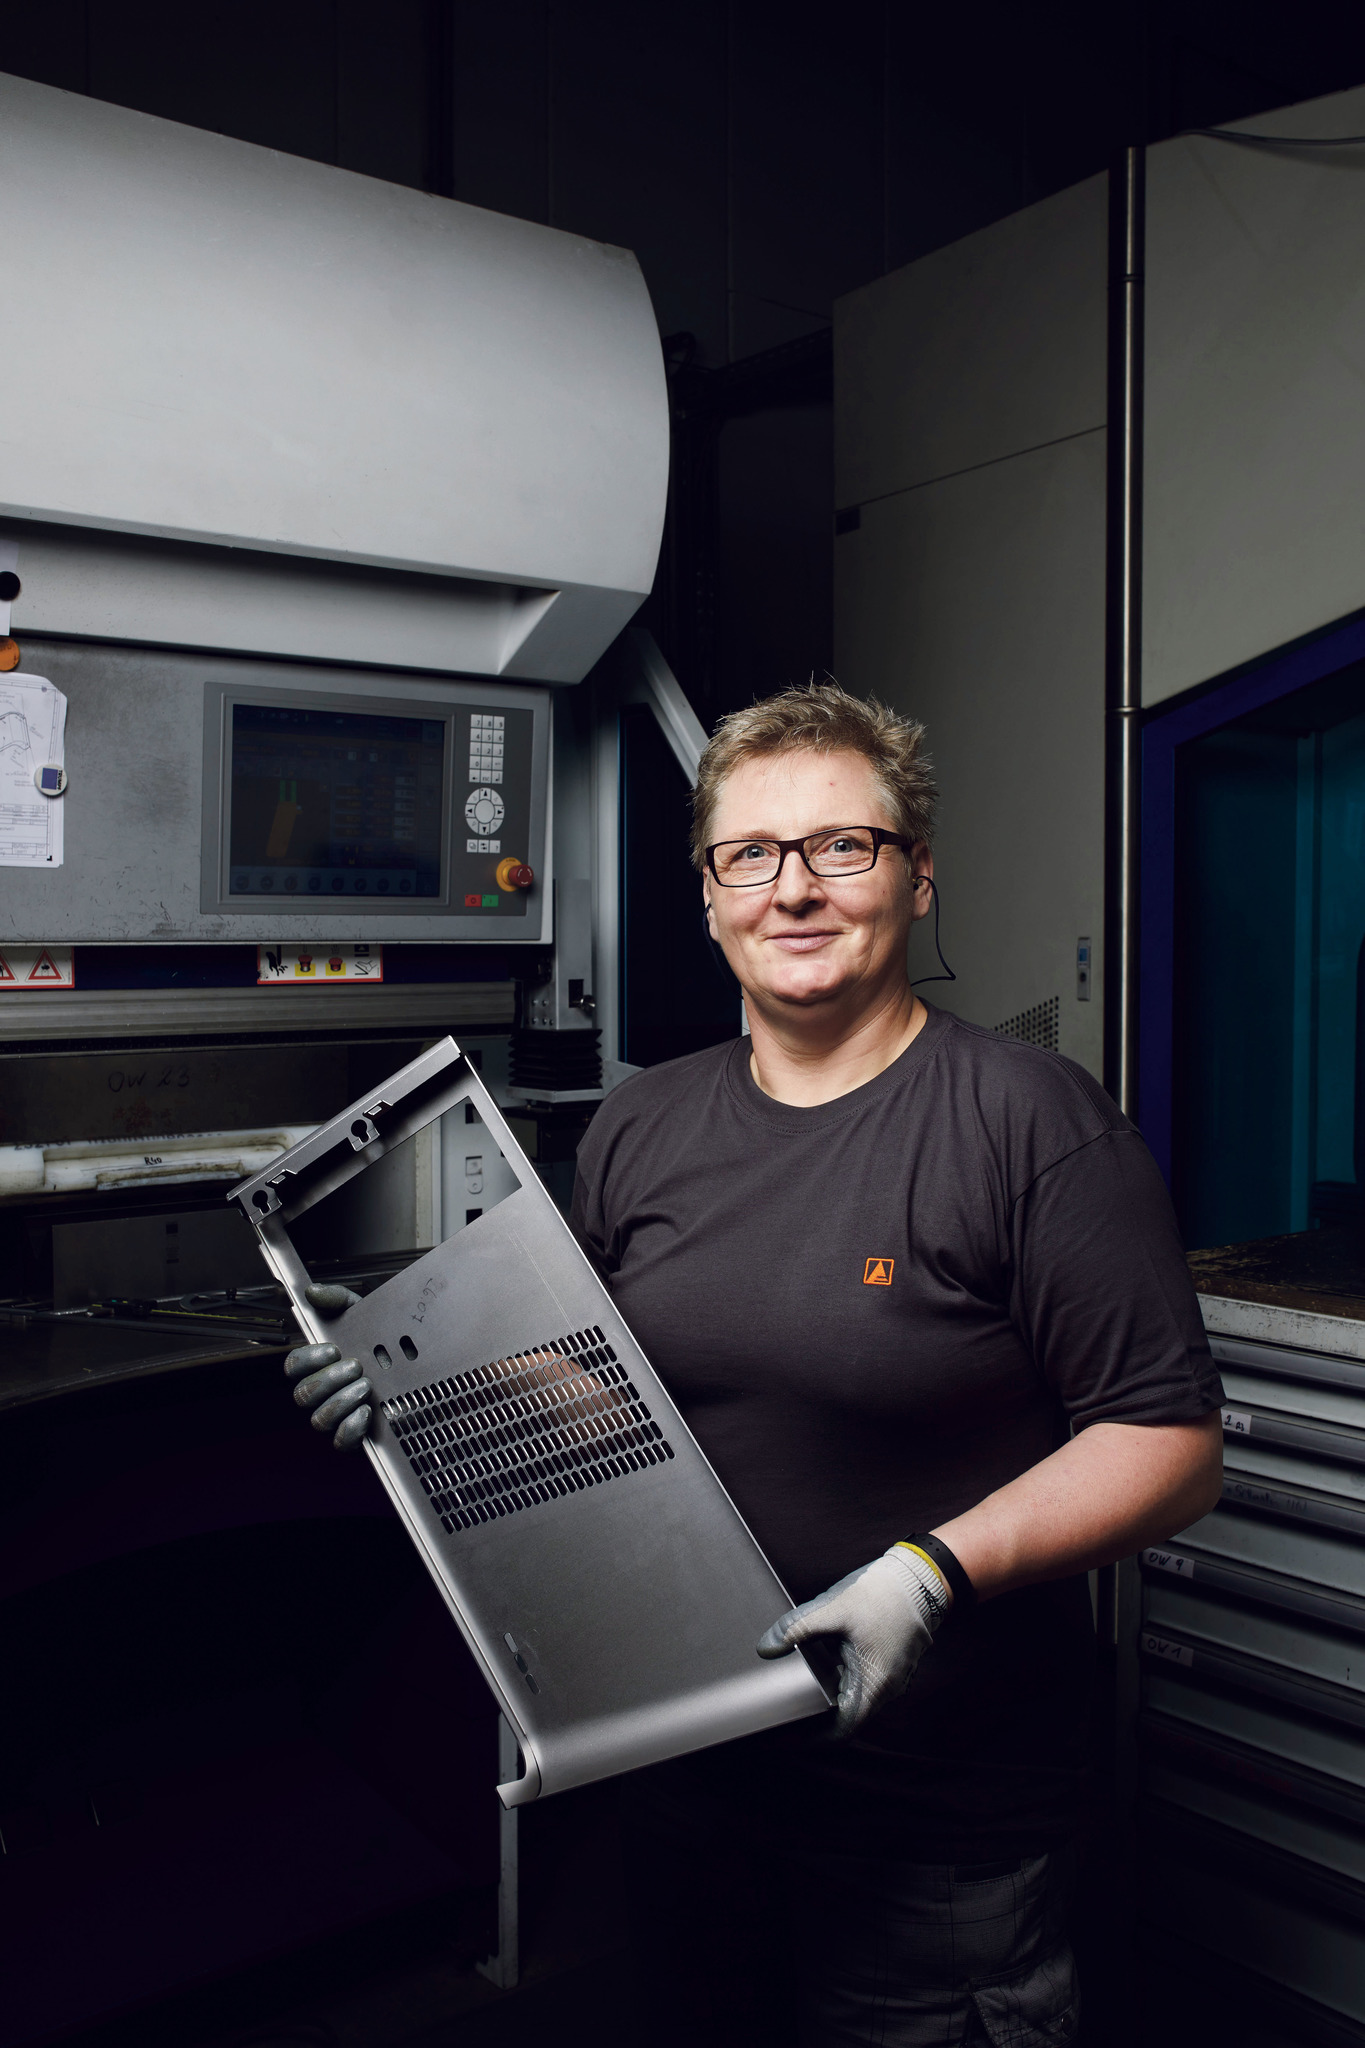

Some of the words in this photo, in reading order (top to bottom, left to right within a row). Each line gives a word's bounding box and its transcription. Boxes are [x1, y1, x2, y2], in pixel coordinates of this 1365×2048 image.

[1148, 1552, 1172, 1566] OW
[1175, 1558, 1184, 1571] 9
[1147, 1637, 1169, 1654] OW
[1171, 1646, 1182, 1659] 1
